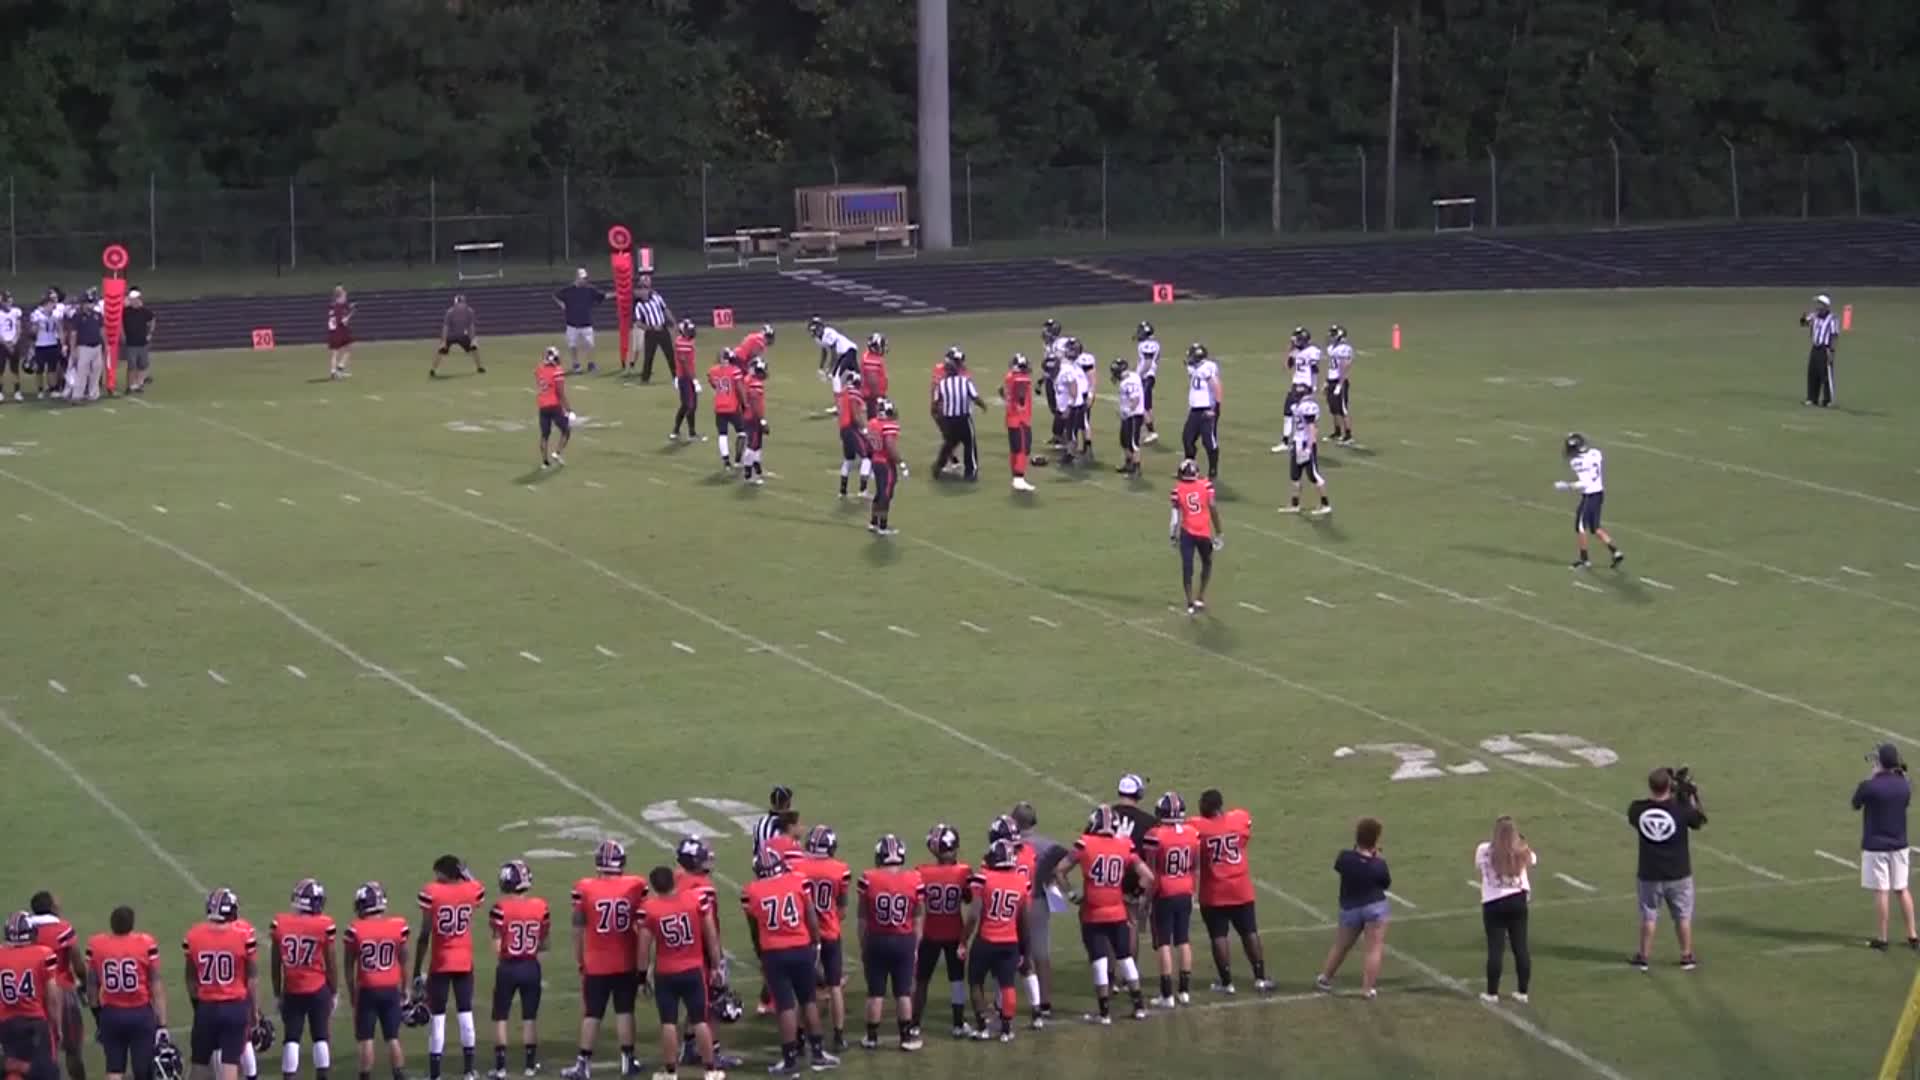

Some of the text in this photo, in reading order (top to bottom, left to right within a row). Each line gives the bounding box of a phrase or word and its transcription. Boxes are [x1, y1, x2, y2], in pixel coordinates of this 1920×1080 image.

[1158, 287, 1168, 300] G
[717, 311, 731, 326] 10
[255, 331, 271, 346] 20
[1186, 491, 1202, 515] 5
[1166, 846, 1191, 878] 81
[1207, 832, 1241, 865] 75
[1089, 854, 1123, 887] 40
[437, 904, 472, 935] 26
[595, 898, 631, 933] 76
[761, 893, 799, 930] 74
[876, 892, 909, 926] 99
[988, 888, 1020, 921] 15
[508, 921, 540, 955] 35
[660, 912, 694, 947] 51
[283, 935, 317, 966] 37
[361, 939, 396, 971] 20
[102, 958, 139, 992] 66
[198, 951, 234, 985] 70
[0, 968, 36, 1004] 64
